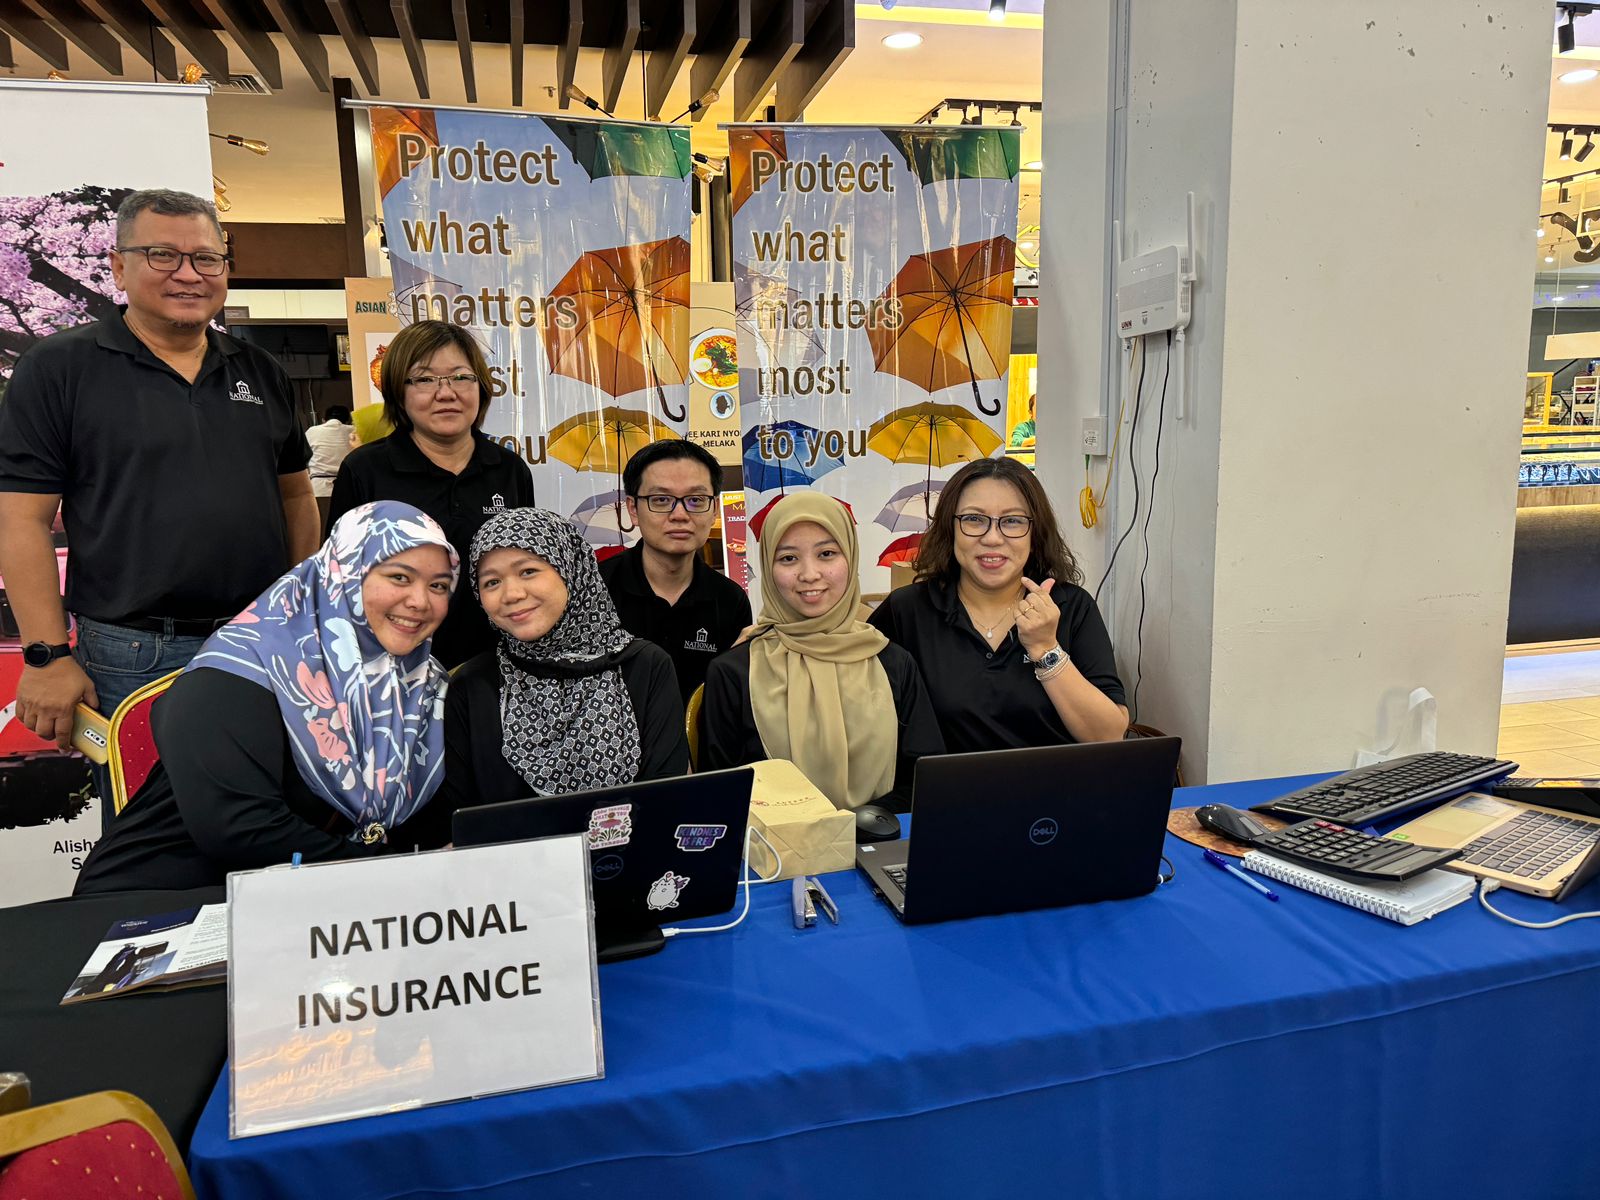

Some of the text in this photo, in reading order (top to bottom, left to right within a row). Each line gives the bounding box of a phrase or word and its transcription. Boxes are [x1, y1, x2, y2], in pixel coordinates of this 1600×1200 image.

[399, 134, 560, 186] Protect
[752, 151, 894, 194] Protect
[402, 211, 512, 256] what
[753, 222, 847, 262] what
[355, 301, 387, 314] ASIAN
[411, 287, 578, 329] matters
[755, 293, 904, 331] matters
[229, 390, 261, 403] NATIONAL
[487, 359, 526, 398] st
[757, 360, 851, 395] most
[688, 429, 742, 438] EE KARI NYO
[702, 439, 736, 448] MELAKA
[758, 426, 867, 468] to you
[684, 640, 717, 651] NATIONAL
[53, 838, 97, 854] Alish
[678, 827, 725, 837] KINDNESS
[1033, 825, 1055, 836] DELL
[309, 900, 528, 959] NATIONAL
[297, 962, 542, 1028] INSURANCE
